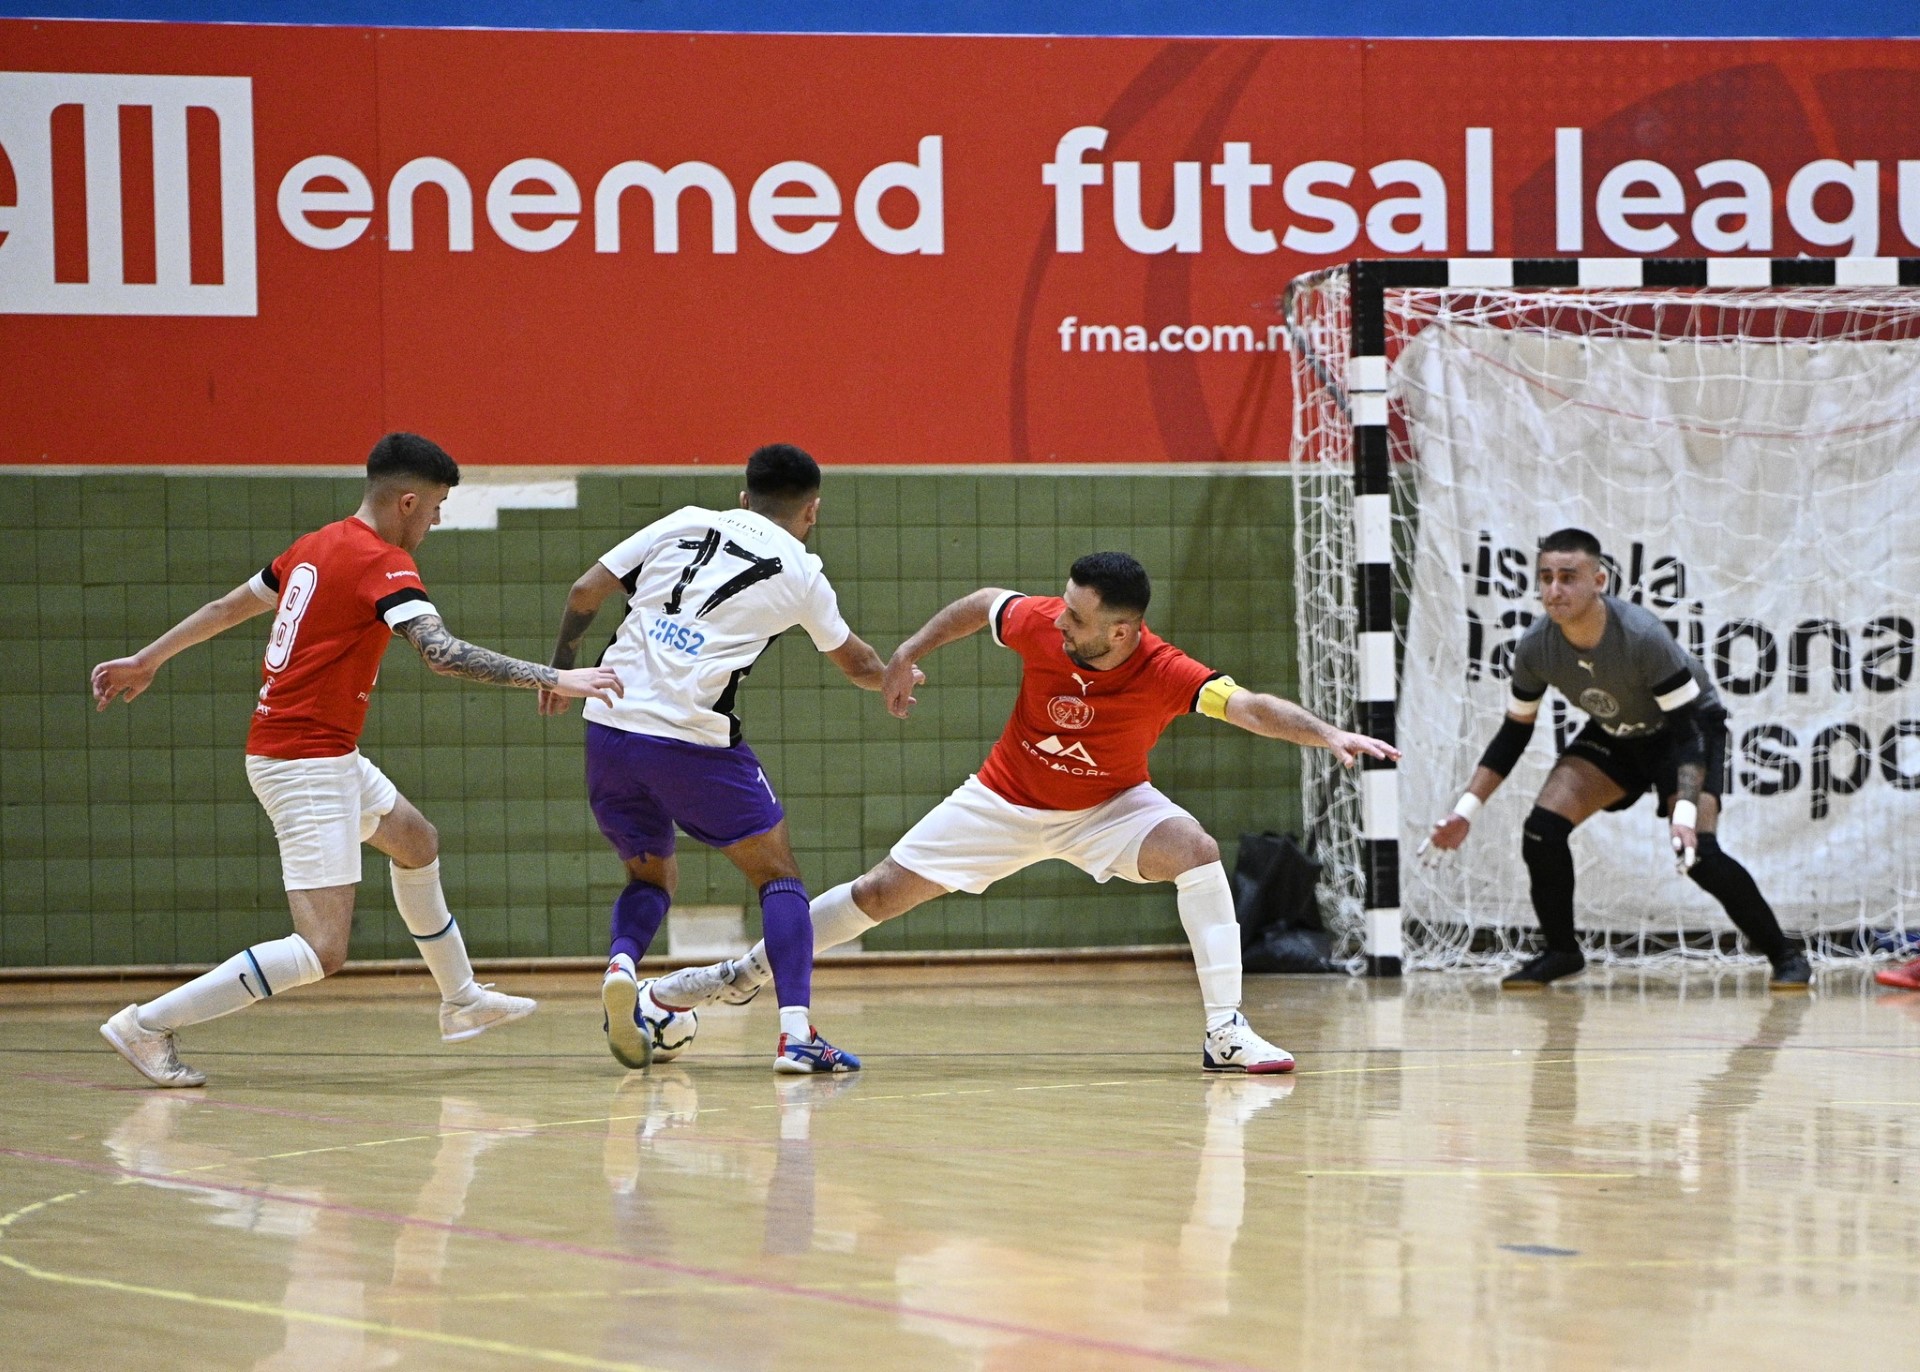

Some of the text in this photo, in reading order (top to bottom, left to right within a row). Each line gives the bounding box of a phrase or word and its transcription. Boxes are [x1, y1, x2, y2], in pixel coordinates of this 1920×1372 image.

[276, 135, 945, 256] enemed
[1042, 125, 1920, 259] futsal leag
[263, 561, 319, 674] 8
[661, 527, 784, 620] 77
